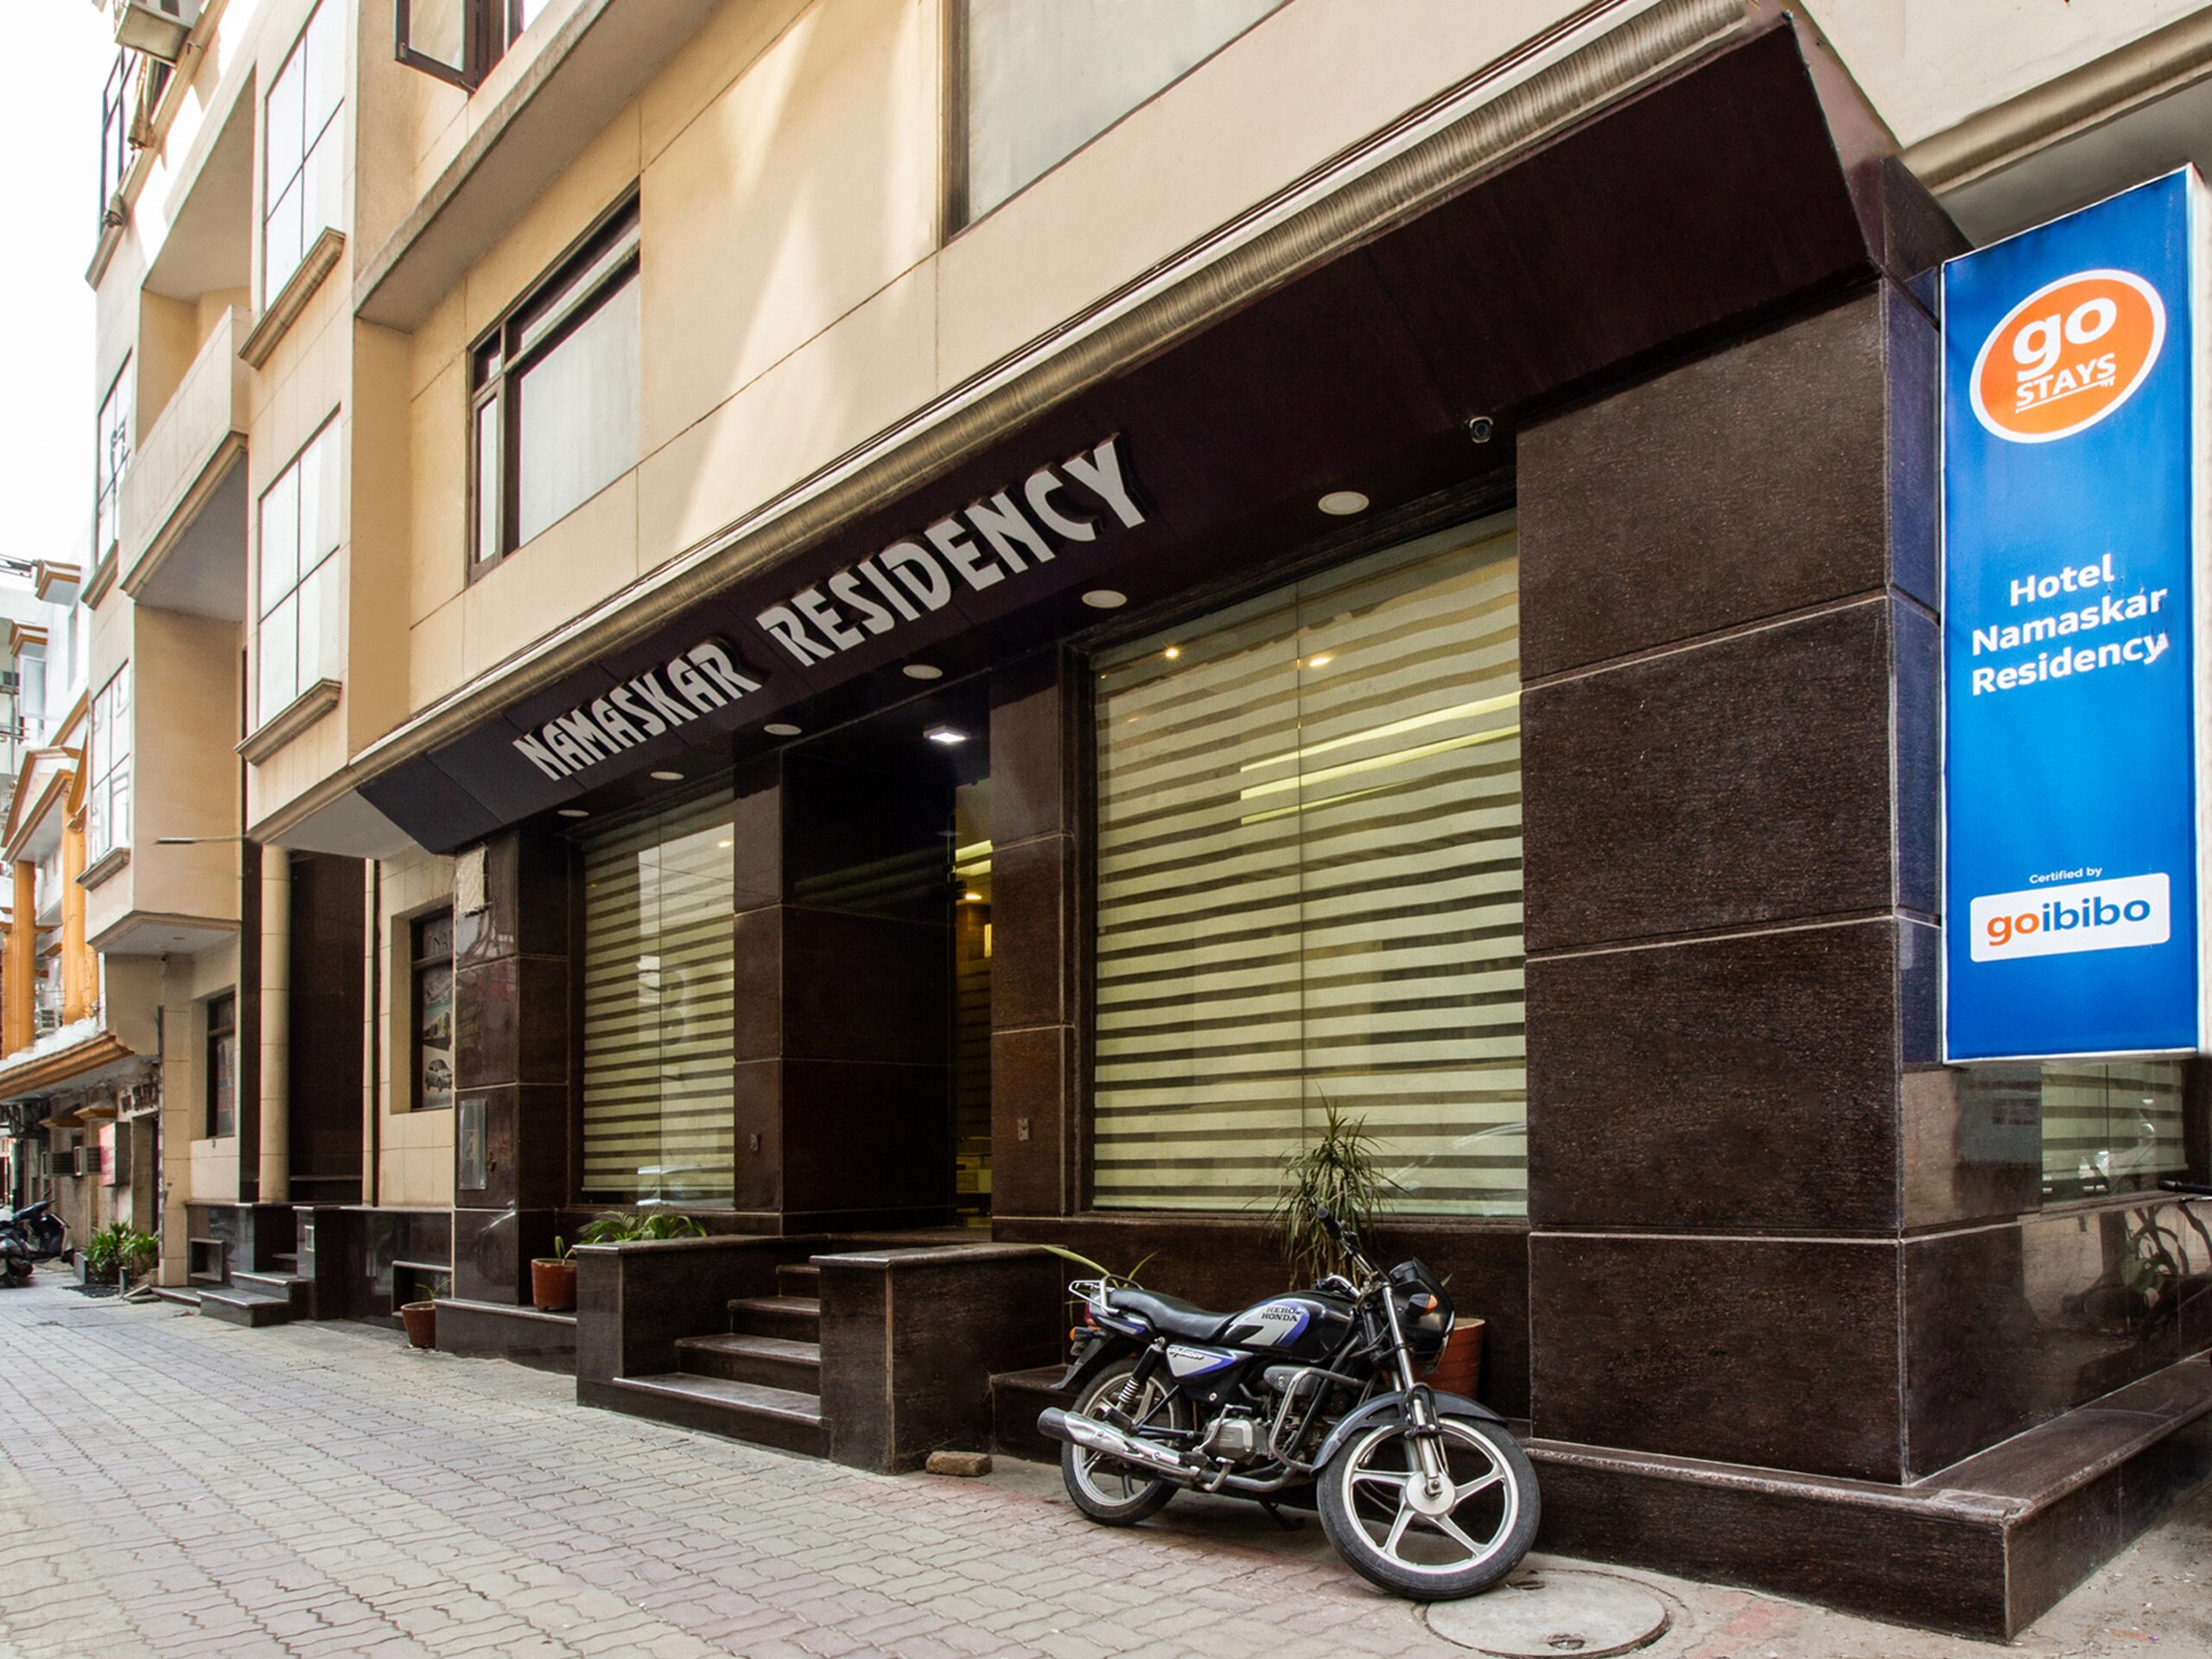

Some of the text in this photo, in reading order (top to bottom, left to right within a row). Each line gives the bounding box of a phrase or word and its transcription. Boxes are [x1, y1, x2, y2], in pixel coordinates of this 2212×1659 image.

[2012, 297, 2117, 382] go
[2016, 352, 2116, 407] STAYS
[2010, 552, 2115, 607] Hotel
[512, 437, 1146, 781] NAMASKAR RESIDENCY
[1972, 588, 2168, 656] Namaskar
[1972, 632, 2170, 696] Residency
[2029, 867, 2103, 884] Certified by
[1986, 895, 2152, 947] goibibo
[1261, 1313, 1298, 1322] HONDA
